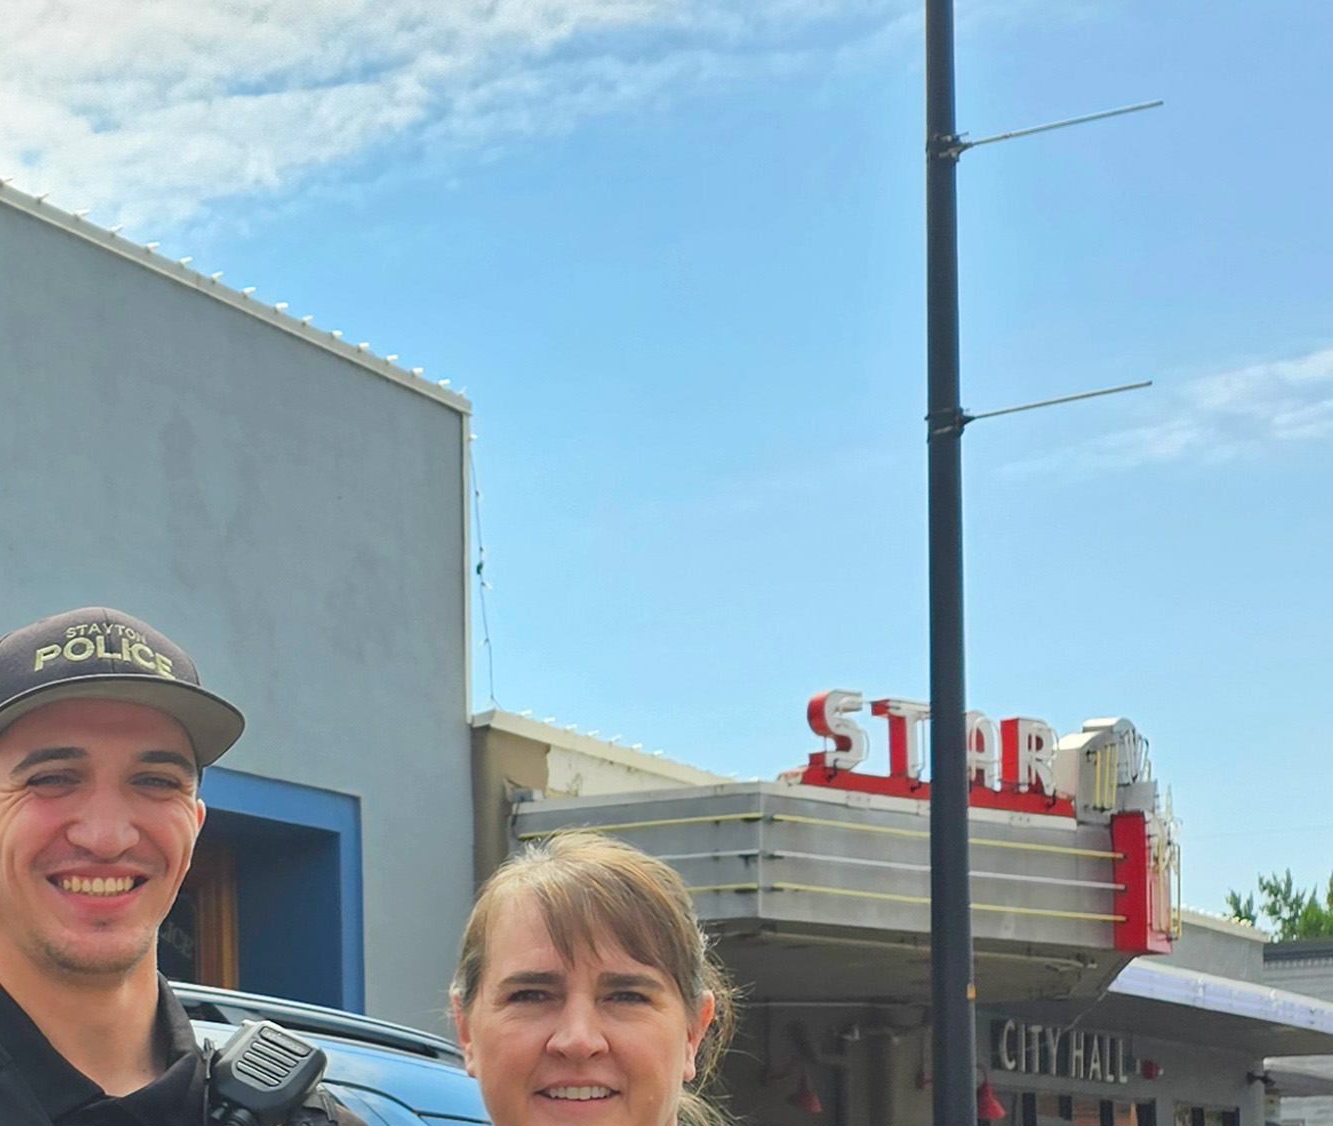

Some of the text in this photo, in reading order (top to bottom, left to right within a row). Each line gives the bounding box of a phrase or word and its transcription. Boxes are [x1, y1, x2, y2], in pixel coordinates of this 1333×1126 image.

[34, 635, 176, 680] POLICE
[66, 622, 148, 644] STAYTON
[807, 689, 1062, 798] STAR
[999, 1019, 1129, 1084] CITY HALL
